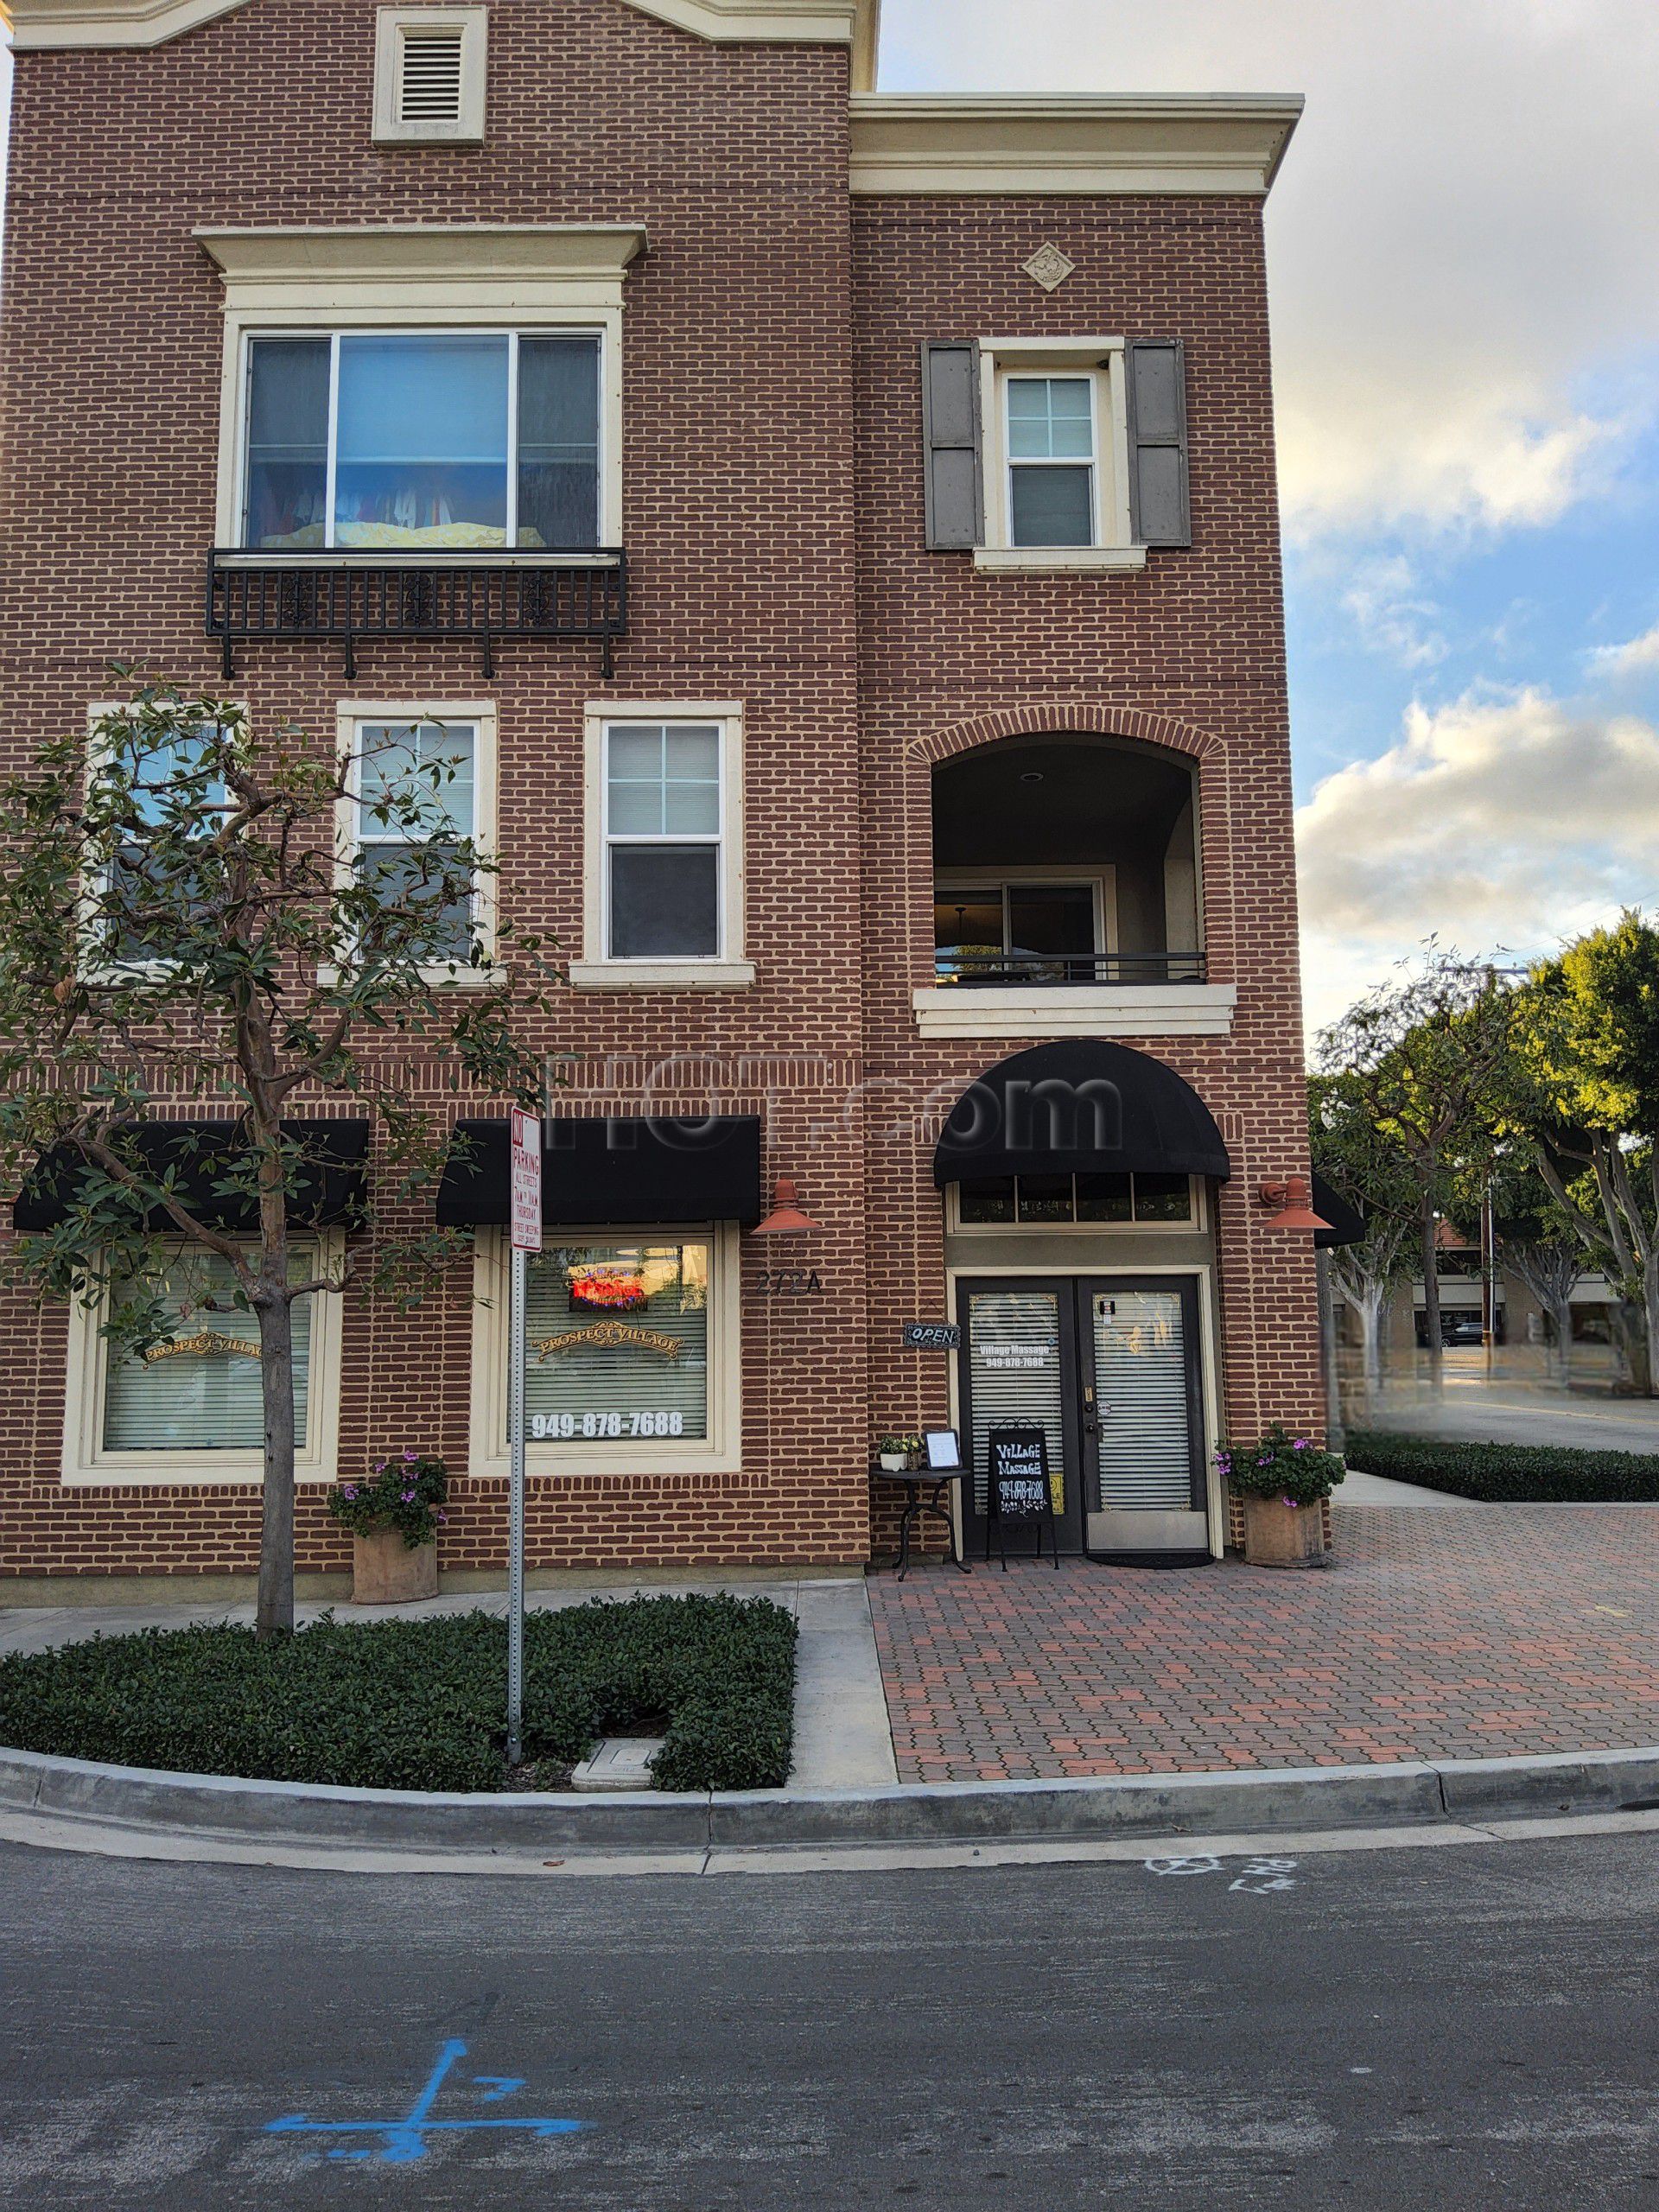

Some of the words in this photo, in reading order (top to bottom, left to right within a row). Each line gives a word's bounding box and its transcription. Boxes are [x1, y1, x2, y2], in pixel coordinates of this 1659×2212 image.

[513, 1112, 523, 1143] NO
[513, 1147, 539, 1176] PARKING
[539, 1328, 614, 1353] PROSPECT
[616, 1328, 679, 1351] VILLAGE
[912, 1327, 955, 1344] OPEN
[145, 1338, 215, 1362] PROSPECT
[979, 1344, 1010, 1356] Village
[1010, 1344, 1050, 1355] Massage
[986, 1357, 1045, 1368] 949-878-7688
[531, 1411, 683, 1439] 949-878-7688
[997, 1460, 1042, 1475] MASSAGE
